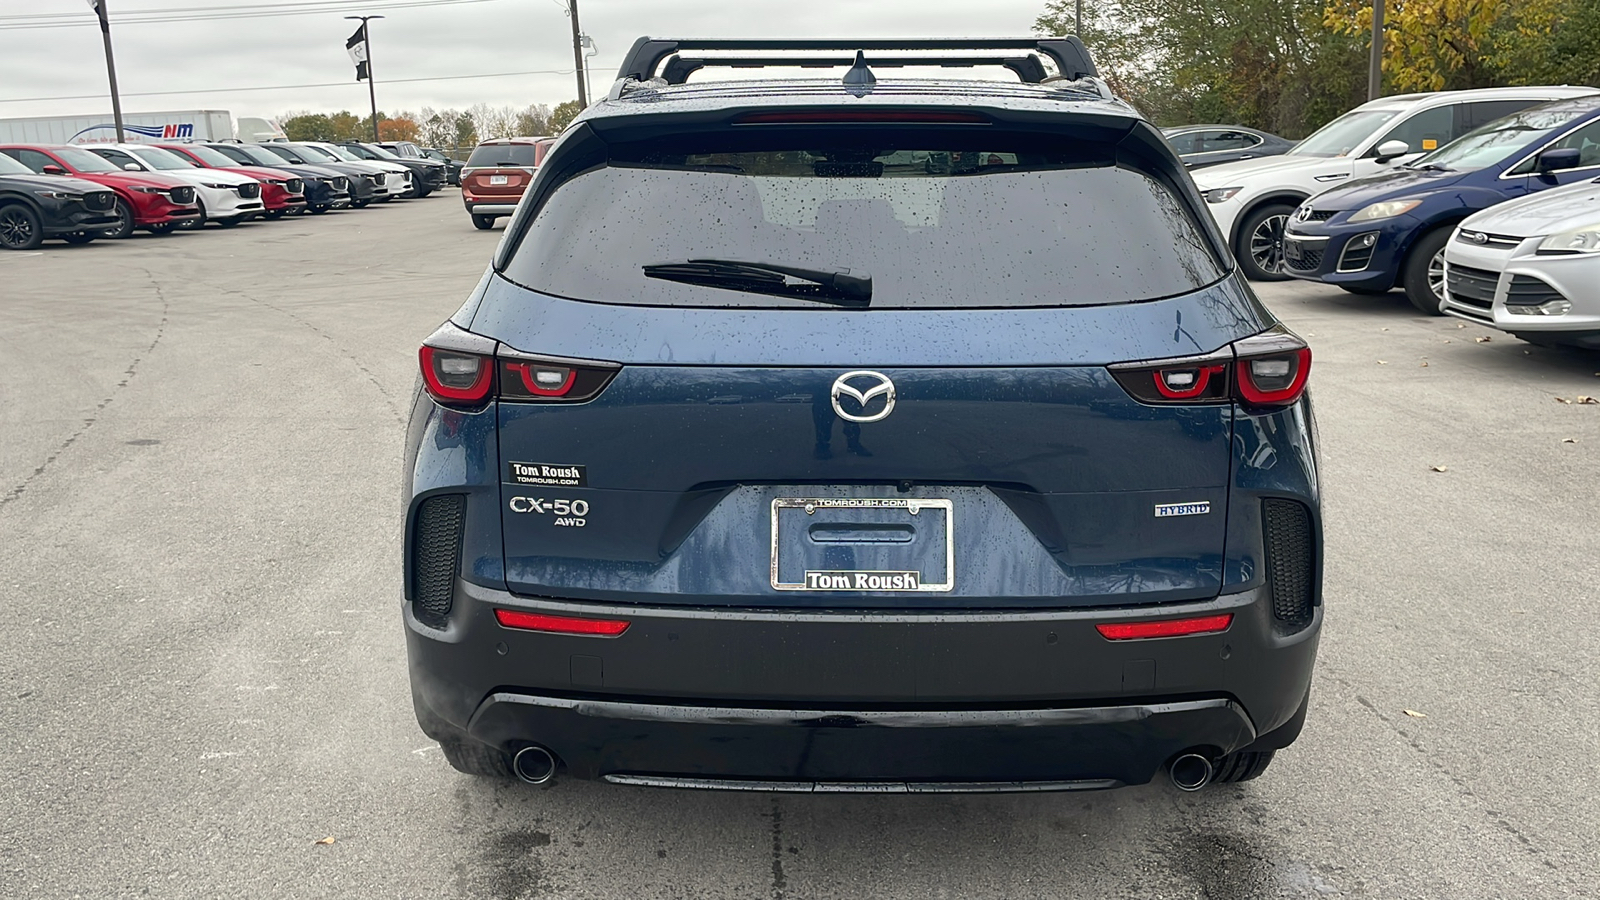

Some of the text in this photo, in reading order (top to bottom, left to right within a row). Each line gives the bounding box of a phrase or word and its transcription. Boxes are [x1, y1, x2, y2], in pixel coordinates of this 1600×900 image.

[513, 463, 580, 478] Tom Roush
[517, 477, 579, 485] TOMROUSH.COM
[509, 496, 589, 516] CX-50
[817, 499, 907, 507] TOMROUSH.COM
[1160, 503, 1207, 515] HYBRID
[554, 517, 586, 527] AWD
[807, 572, 917, 589] Tom Roush
